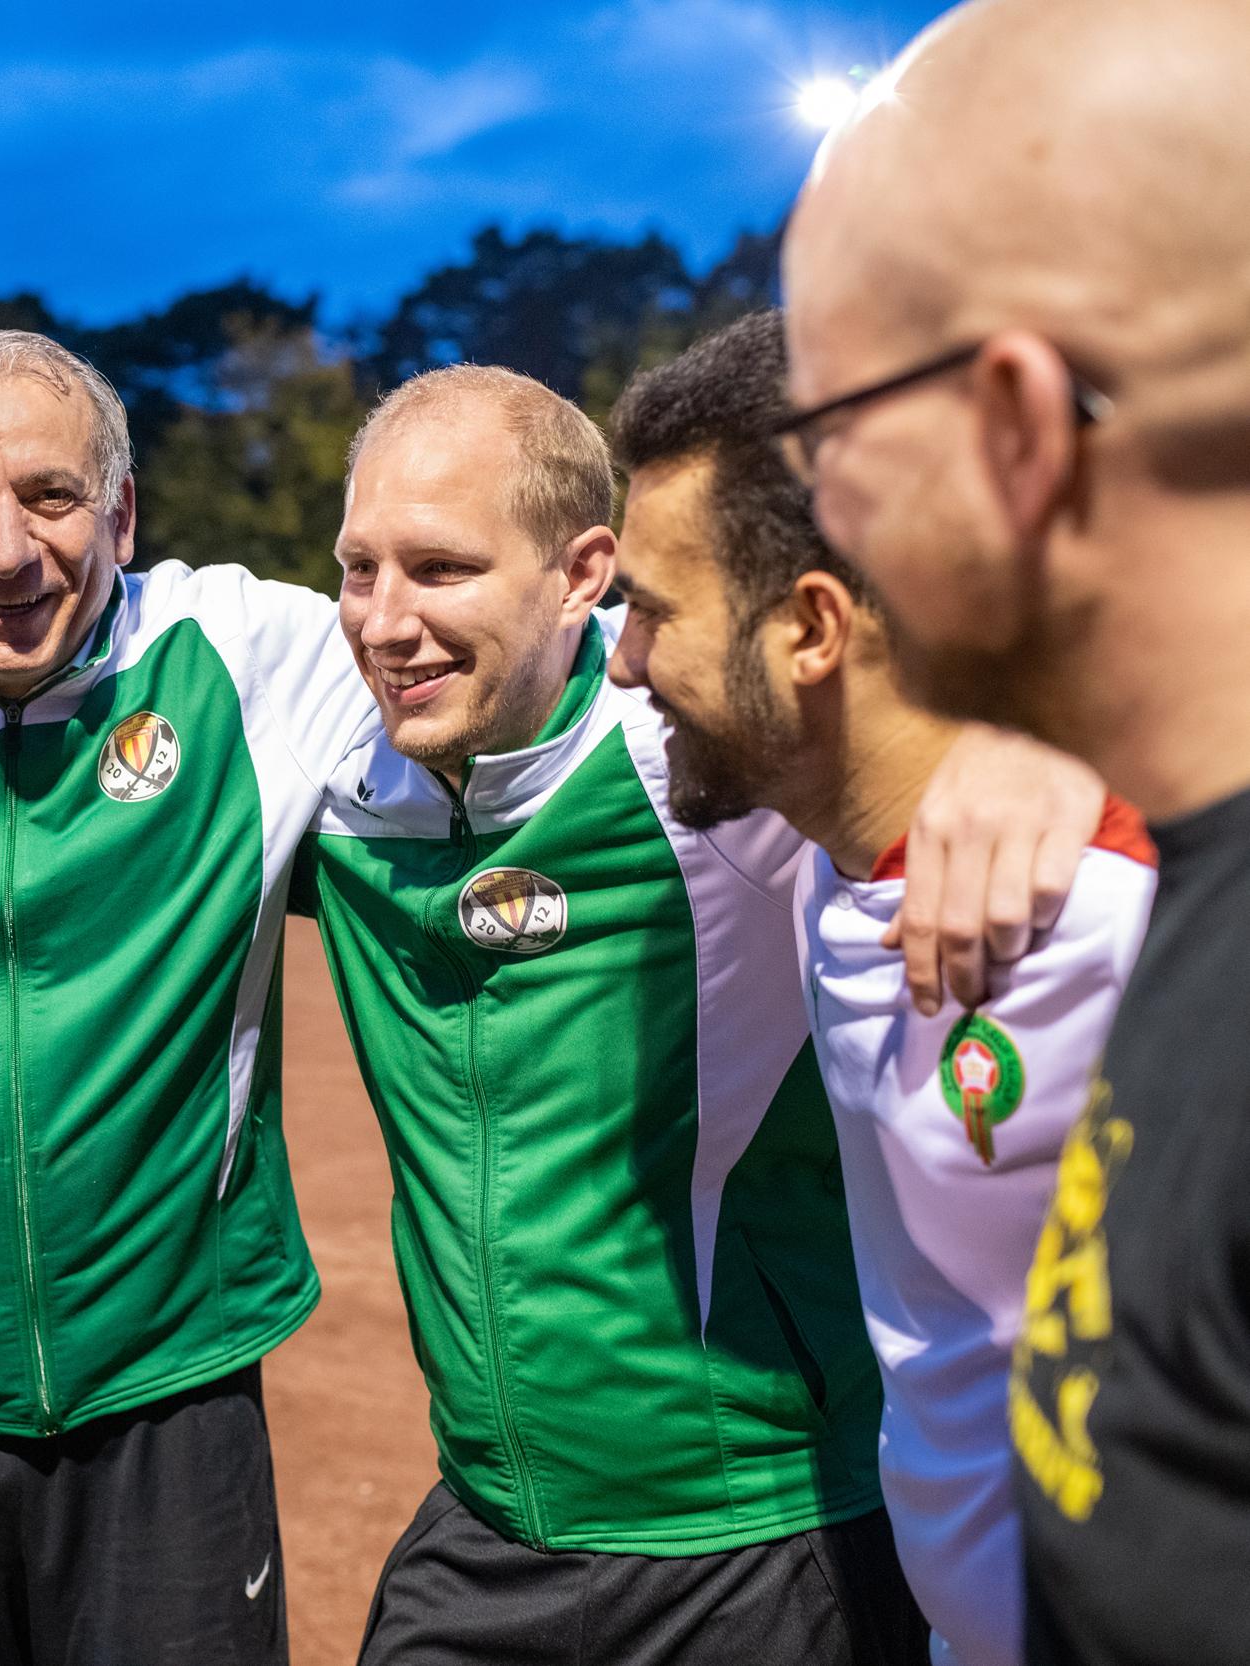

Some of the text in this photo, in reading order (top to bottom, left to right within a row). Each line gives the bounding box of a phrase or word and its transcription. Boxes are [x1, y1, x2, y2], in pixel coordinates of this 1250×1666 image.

[106, 750, 169, 779] 20 12
[477, 906, 551, 936] 20 12
